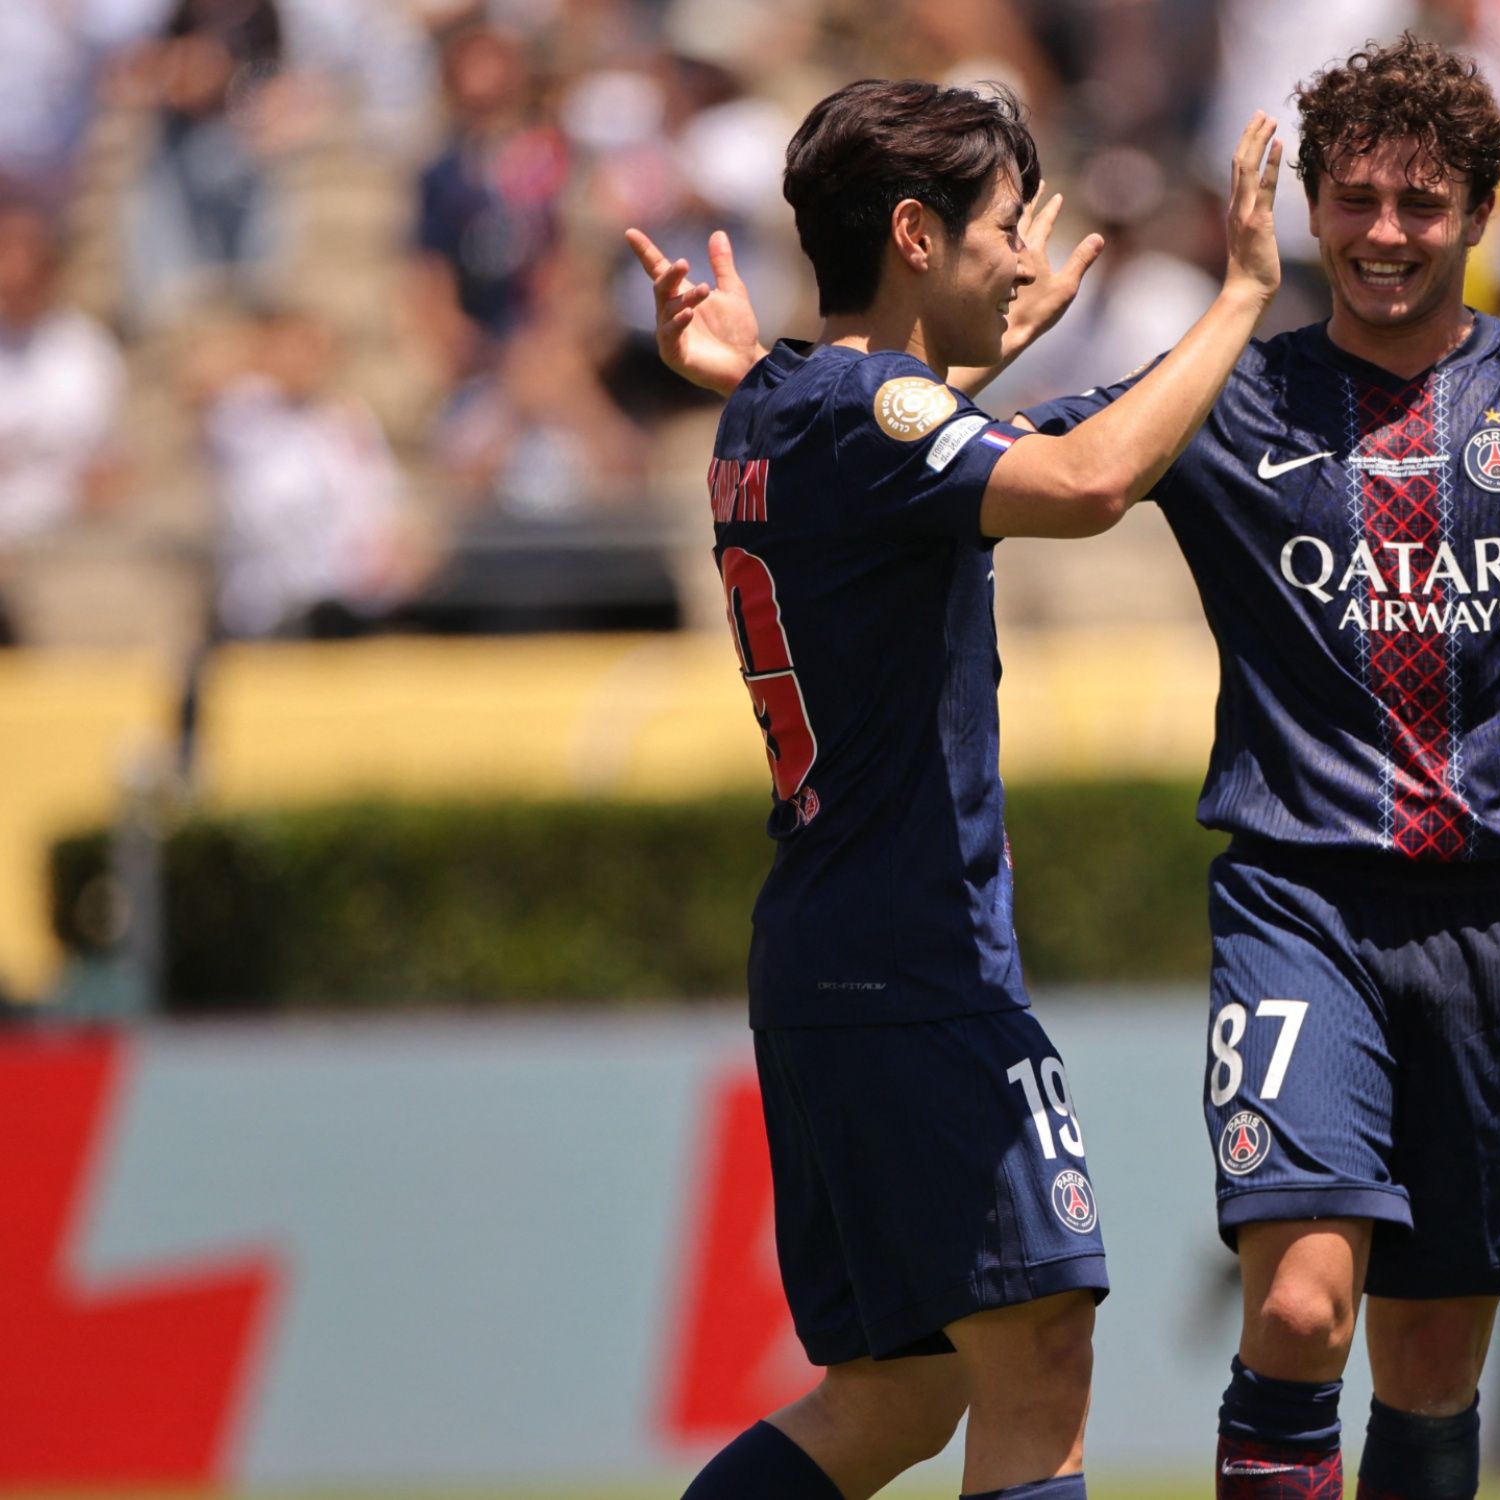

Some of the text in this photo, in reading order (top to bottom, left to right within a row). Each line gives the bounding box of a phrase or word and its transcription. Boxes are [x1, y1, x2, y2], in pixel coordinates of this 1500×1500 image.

[881, 383, 901, 417] WORLD
[887, 417, 911, 434] CLUB
[1210, 999, 1310, 1107] 87
[1006, 1056, 1086, 1160] 19
[1227, 1114, 1261, 1133] PARIS
[1056, 1172, 1085, 1190] PARIS
